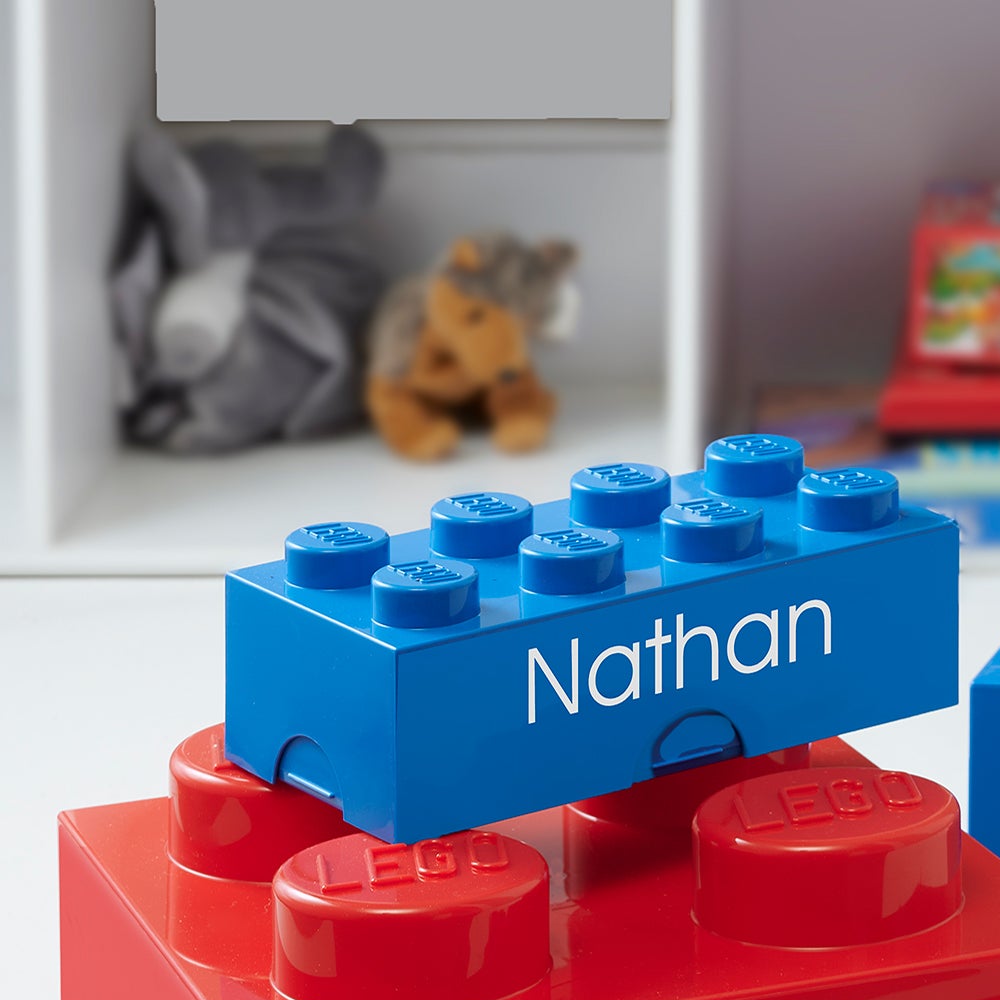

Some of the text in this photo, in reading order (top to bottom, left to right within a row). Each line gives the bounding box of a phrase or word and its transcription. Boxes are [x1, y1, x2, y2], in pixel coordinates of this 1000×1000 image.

[527, 598, 833, 725] Nathan
[734, 771, 923, 832] LEGO
[315, 831, 510, 894] LEGO
